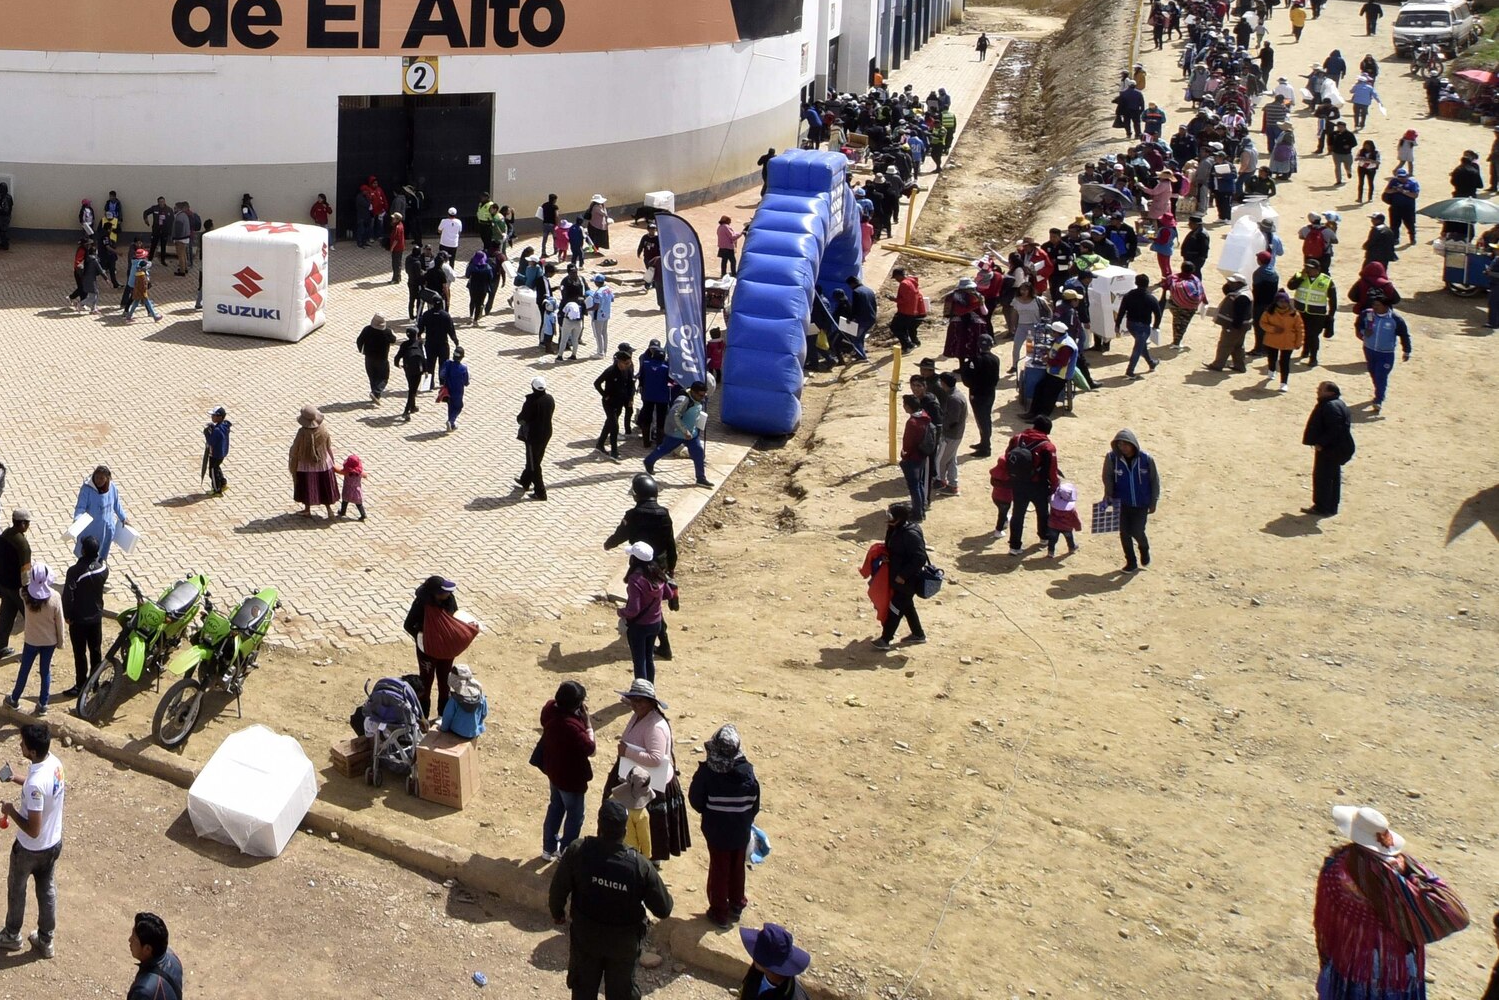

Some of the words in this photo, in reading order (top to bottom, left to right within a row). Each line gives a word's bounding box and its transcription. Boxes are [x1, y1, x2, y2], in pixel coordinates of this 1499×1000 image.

[413, 66, 427, 90] 2
[216, 303, 281, 320] SUZUKI
[592, 876, 628, 892] POLICIA
